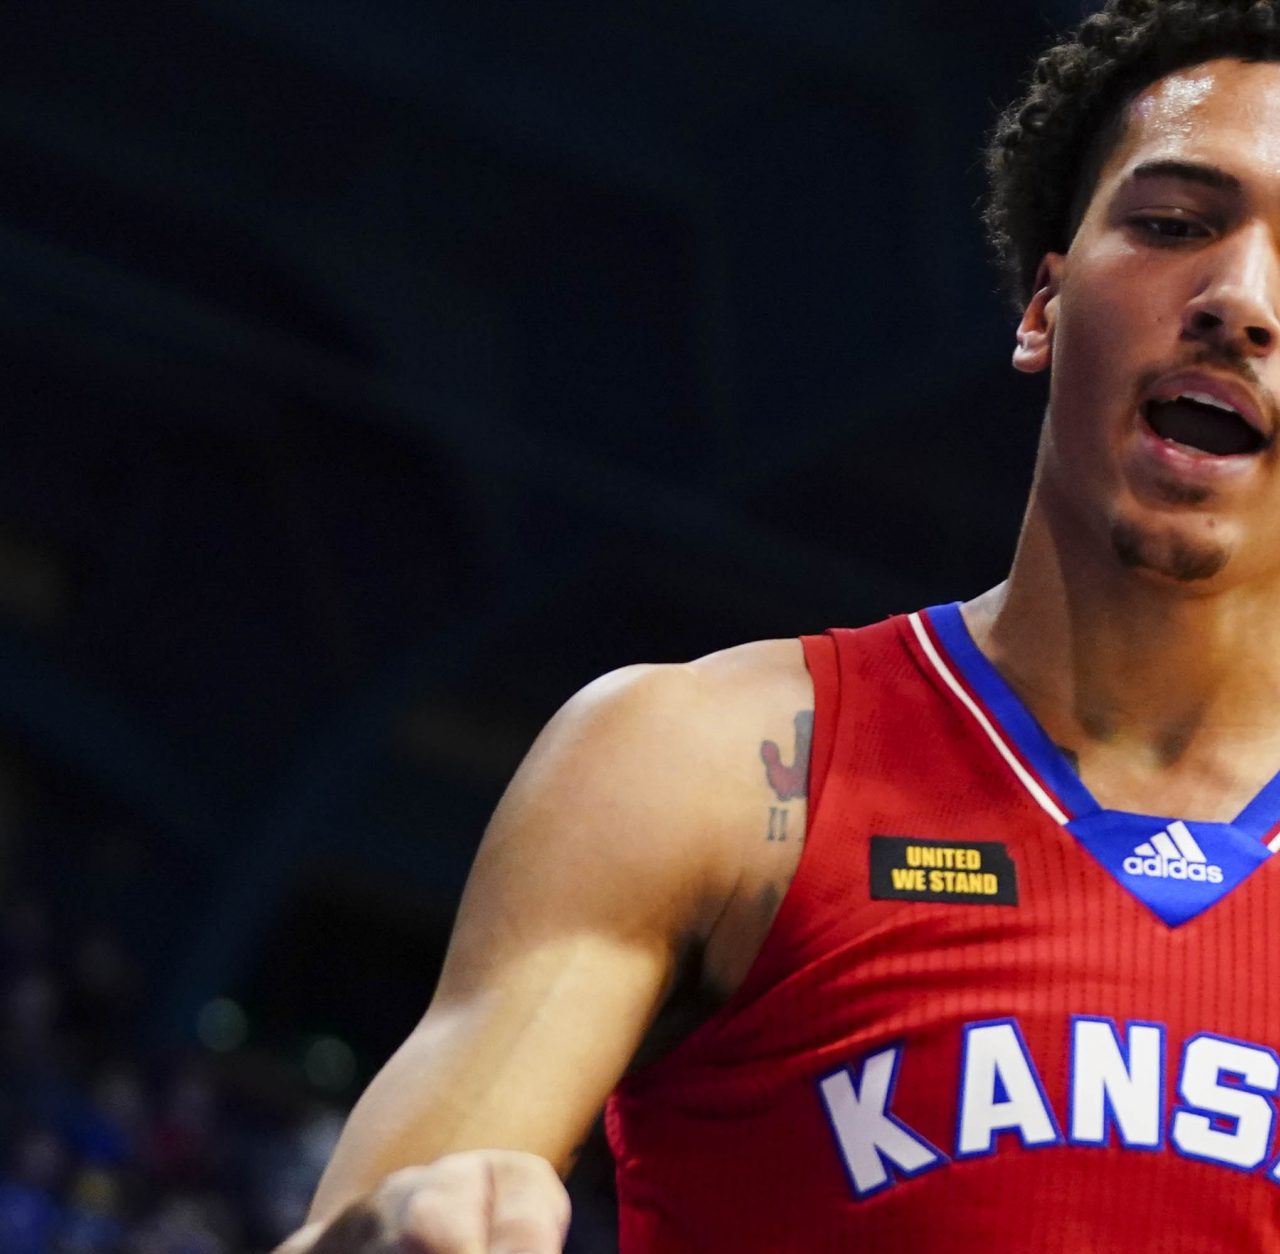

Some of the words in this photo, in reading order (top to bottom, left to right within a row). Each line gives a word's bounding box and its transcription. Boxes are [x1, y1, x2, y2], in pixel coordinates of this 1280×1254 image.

[906, 845, 982, 870] UNITED
[1122, 852, 1224, 884] adidas
[891, 868, 927, 891] WE
[929, 869, 998, 895] STAND
